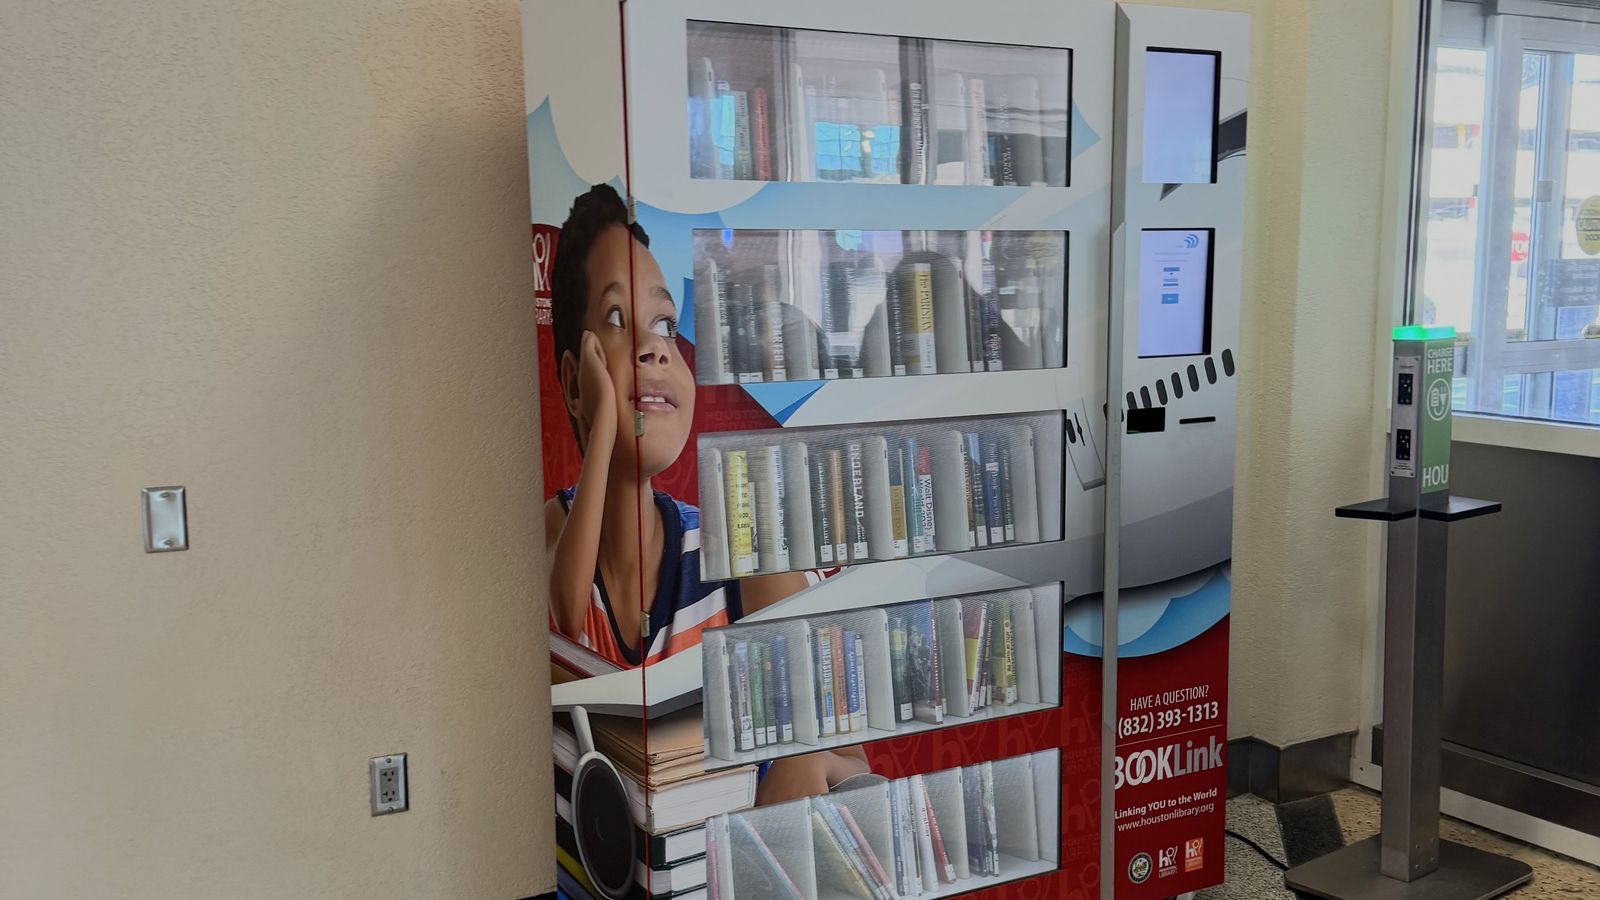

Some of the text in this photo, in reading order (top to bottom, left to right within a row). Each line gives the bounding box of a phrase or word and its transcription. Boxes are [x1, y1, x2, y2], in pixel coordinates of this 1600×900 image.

[1427, 357, 1453, 374] HERE
[923, 478, 933, 499] Walt
[1423, 464, 1449, 488] HOU
[1130, 685, 1209, 711] HAVE A QUESTION?
[1118, 701, 1219, 739] (832) 393-1313
[1114, 788, 1218, 820] Linking YOU to the World
[1117, 803, 1215, 832] www.houstonlibrary.org
